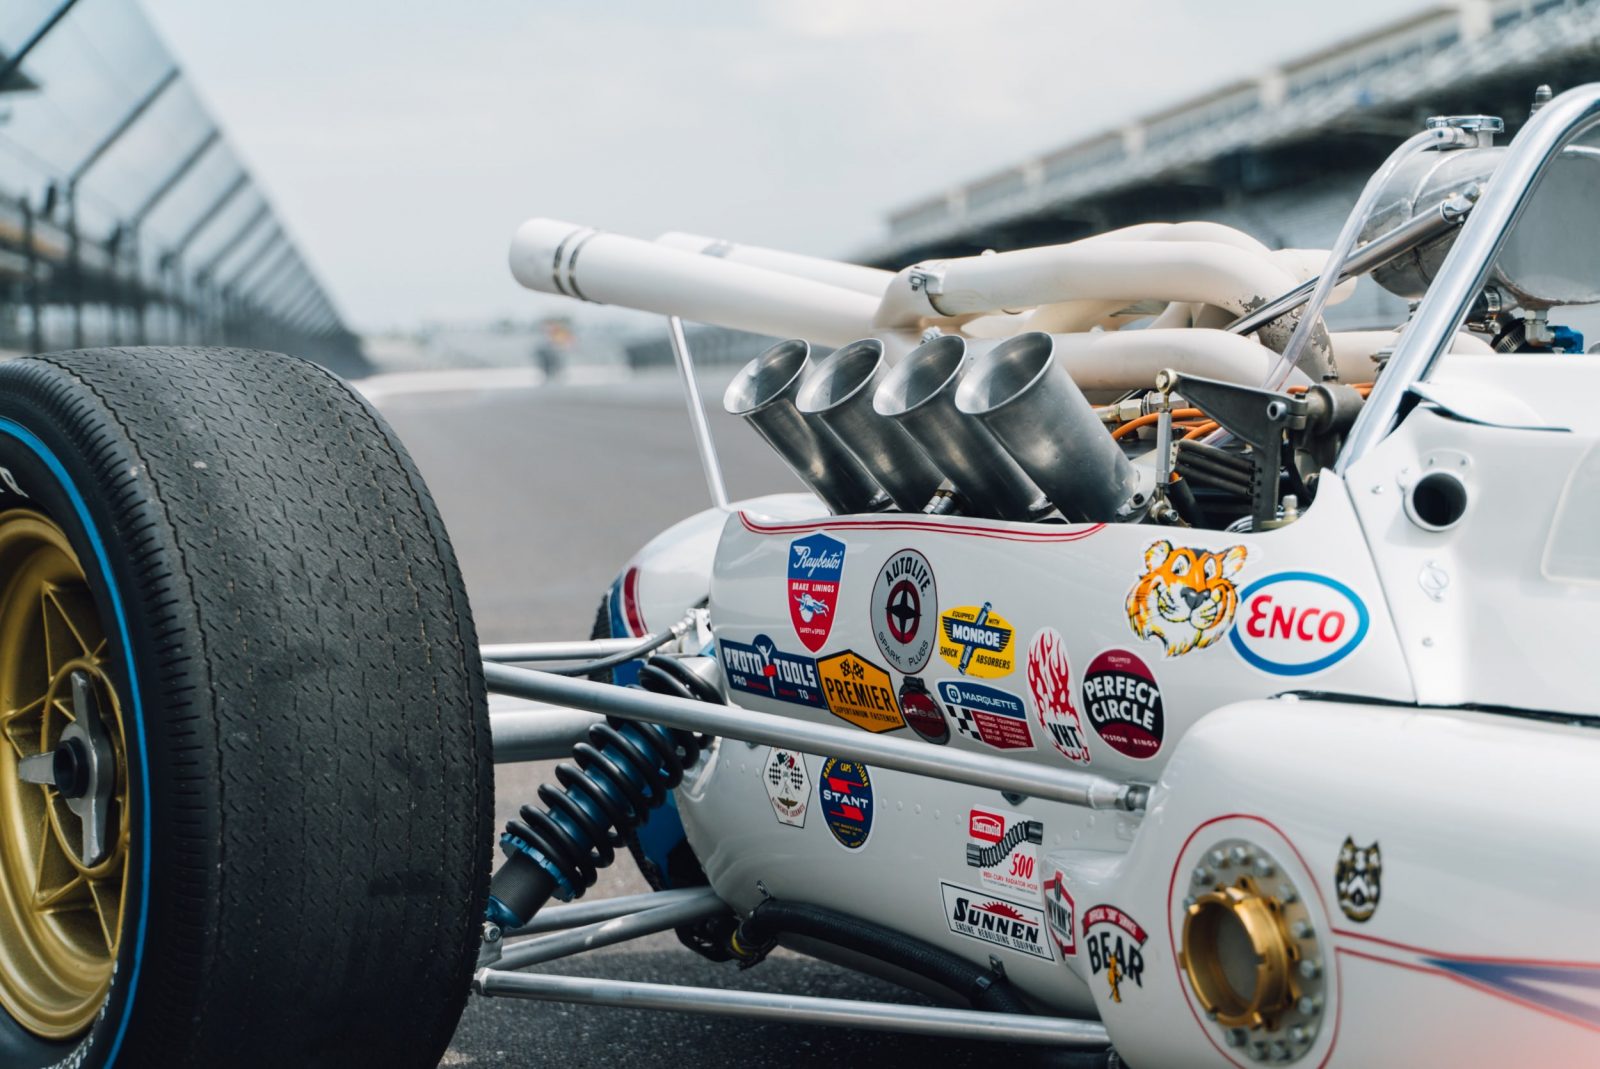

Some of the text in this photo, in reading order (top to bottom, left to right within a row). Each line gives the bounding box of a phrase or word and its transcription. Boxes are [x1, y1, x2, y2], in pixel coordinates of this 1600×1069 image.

[793, 546, 841, 578] Raybestos
[885, 556, 931, 593] AUTOLITE
[792, 582, 834, 593] BRAKE LININGS
[952, 610, 975, 621] EQUIPPED
[1246, 594, 1346, 643] ENCO
[879, 631, 929, 666] SPARK PLUGS
[952, 623, 1000, 648] MONROE
[723, 646, 818, 688] PROTO TOOLS
[939, 646, 1011, 670] SHOCK ABSORBERS
[824, 677, 895, 713] PREMIER
[961, 691, 1018, 711] MARQUETTE
[1083, 675, 1160, 709] PERFECT
[1091, 699, 1155, 731] CIRCLE
[1047, 721, 1083, 750] VHT
[1102, 733, 1128, 743] PISTON
[840, 762, 852, 773] CAPS
[823, 789, 869, 809] STANT
[953, 897, 1039, 944] SUNNEN
[955, 921, 1045, 955] ENGINE REBUILDING EQUIPMENT
[1087, 931, 1144, 989] BEAR
